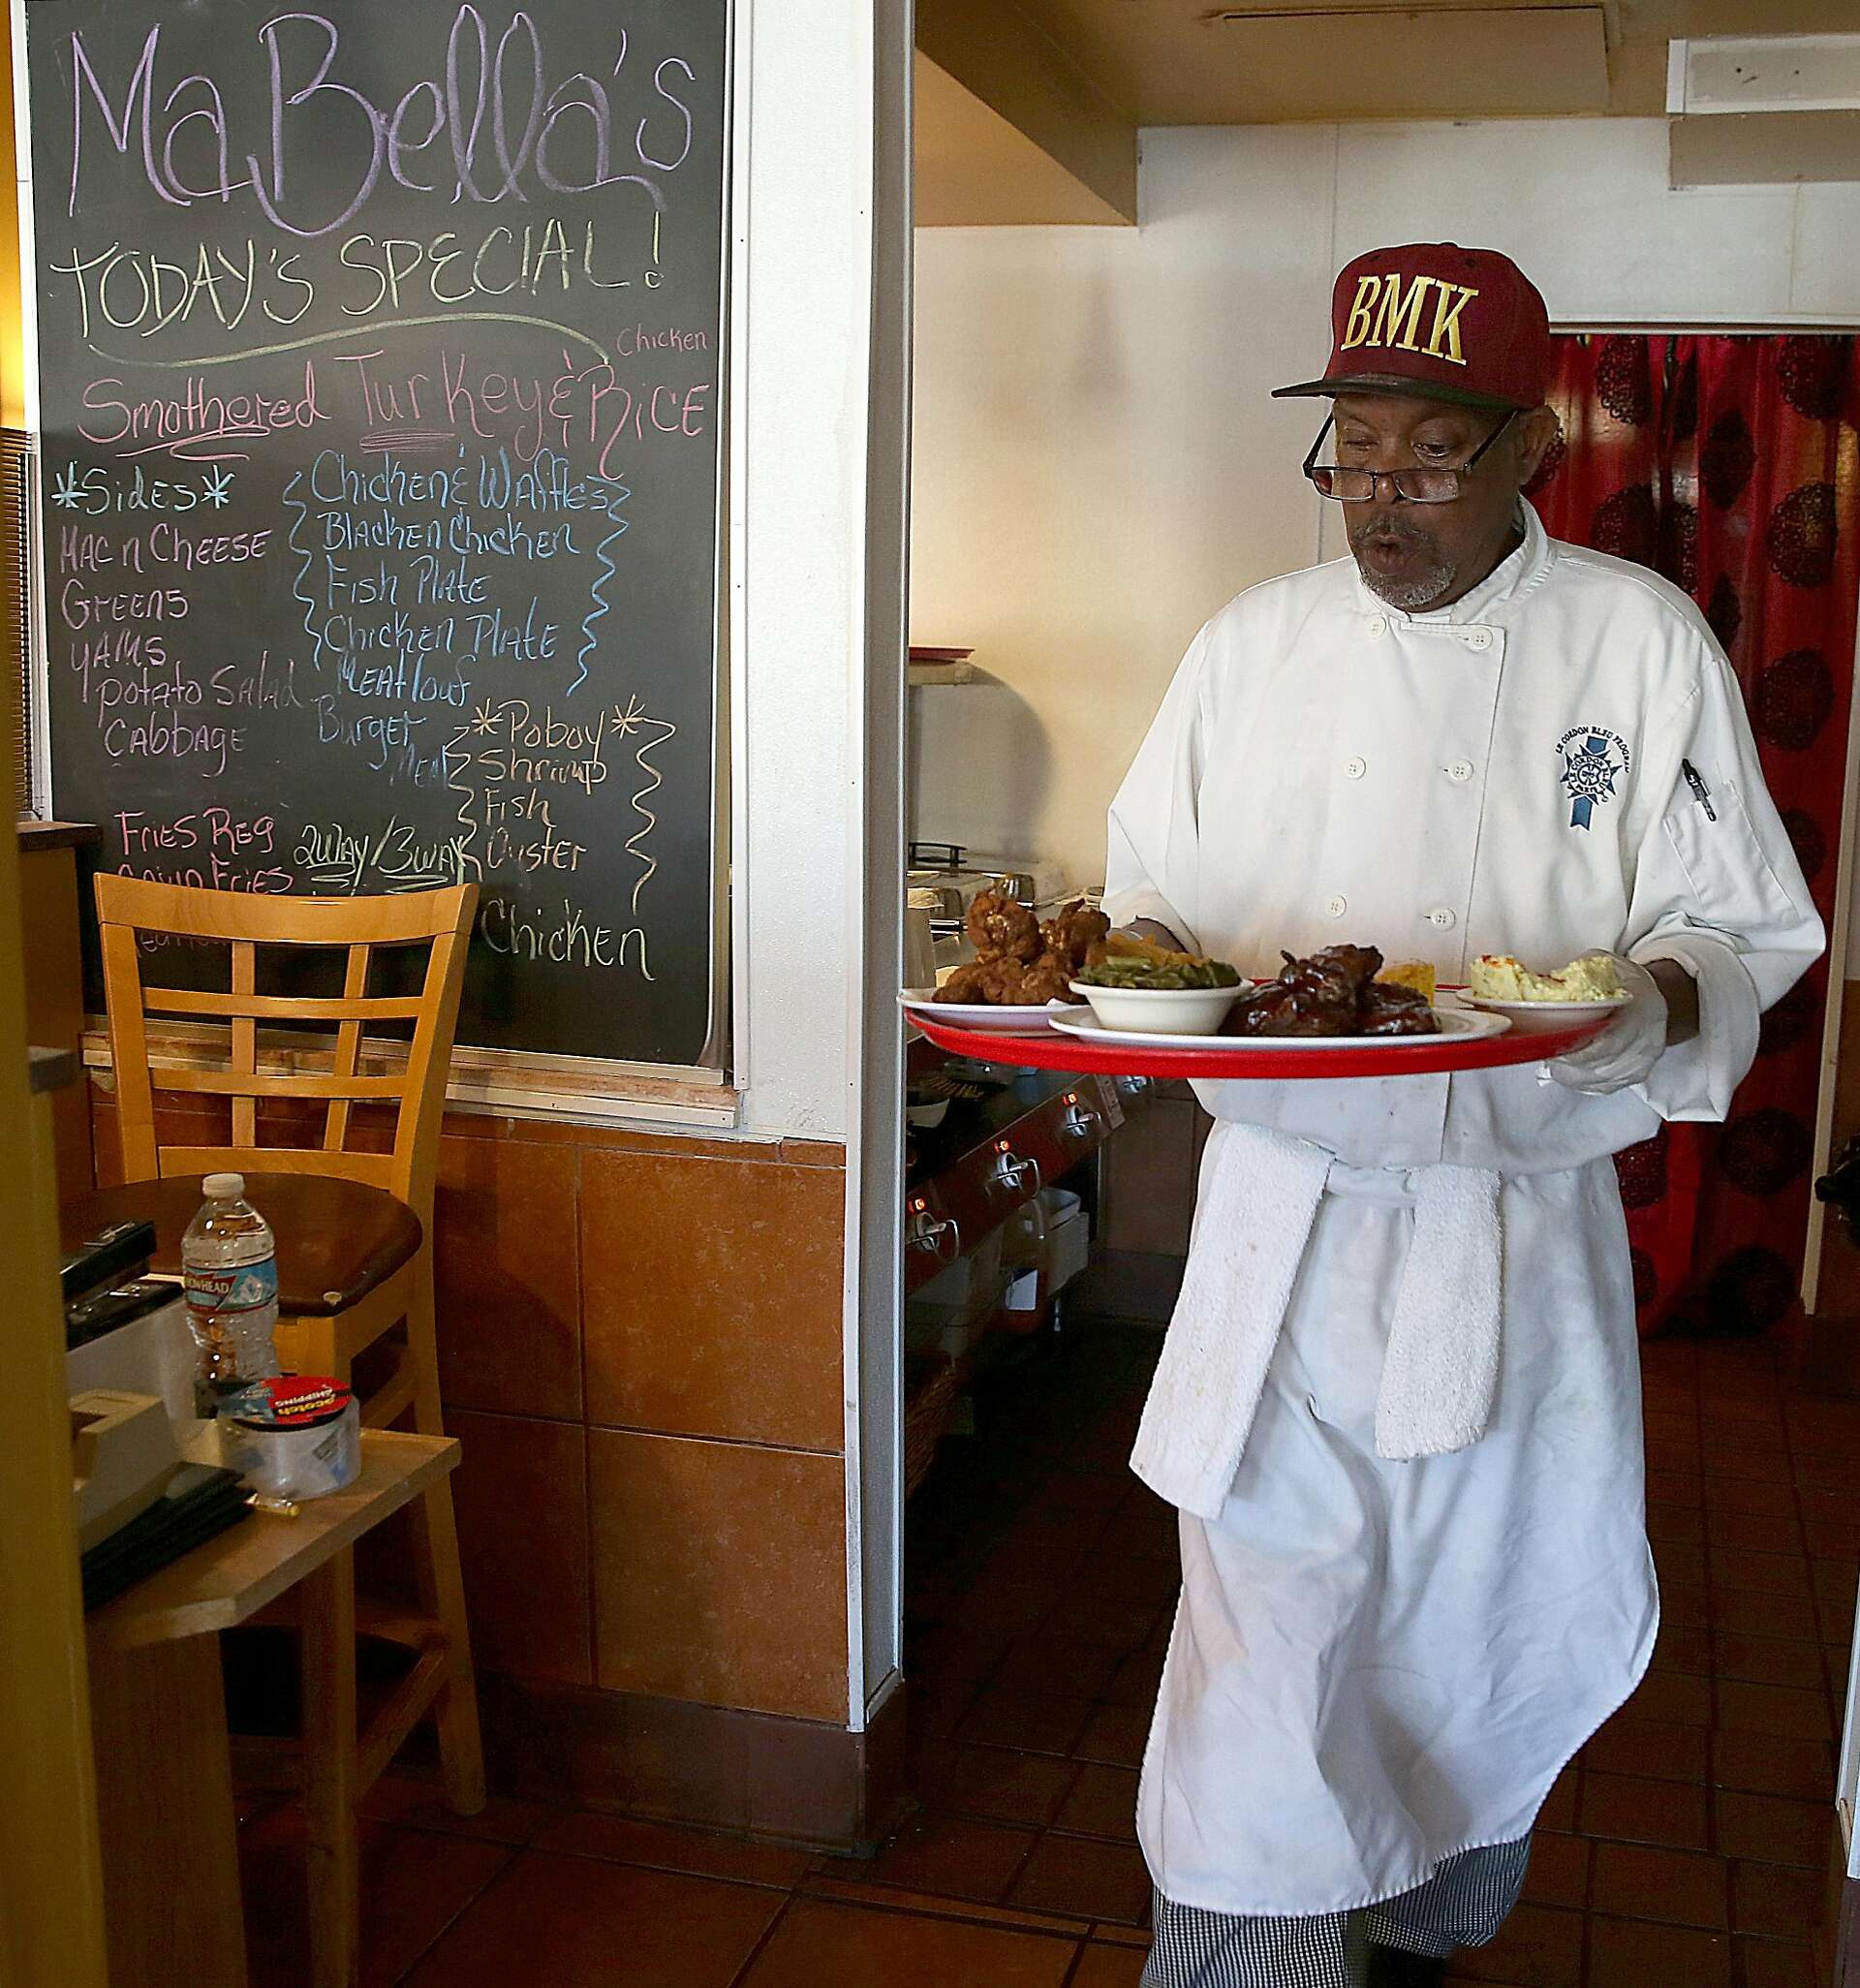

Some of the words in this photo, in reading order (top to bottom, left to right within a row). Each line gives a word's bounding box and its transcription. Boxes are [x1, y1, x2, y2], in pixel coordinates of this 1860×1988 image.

[49, 239, 314, 339] TODAY'S
[616, 324, 708, 357] Chicken
[1340, 273, 1479, 366] BMK
[78, 359, 332, 444] Smothered
[326, 555, 397, 609] Fish
[1561, 726, 1590, 744] CORDON
[484, 788, 557, 827] Fish
